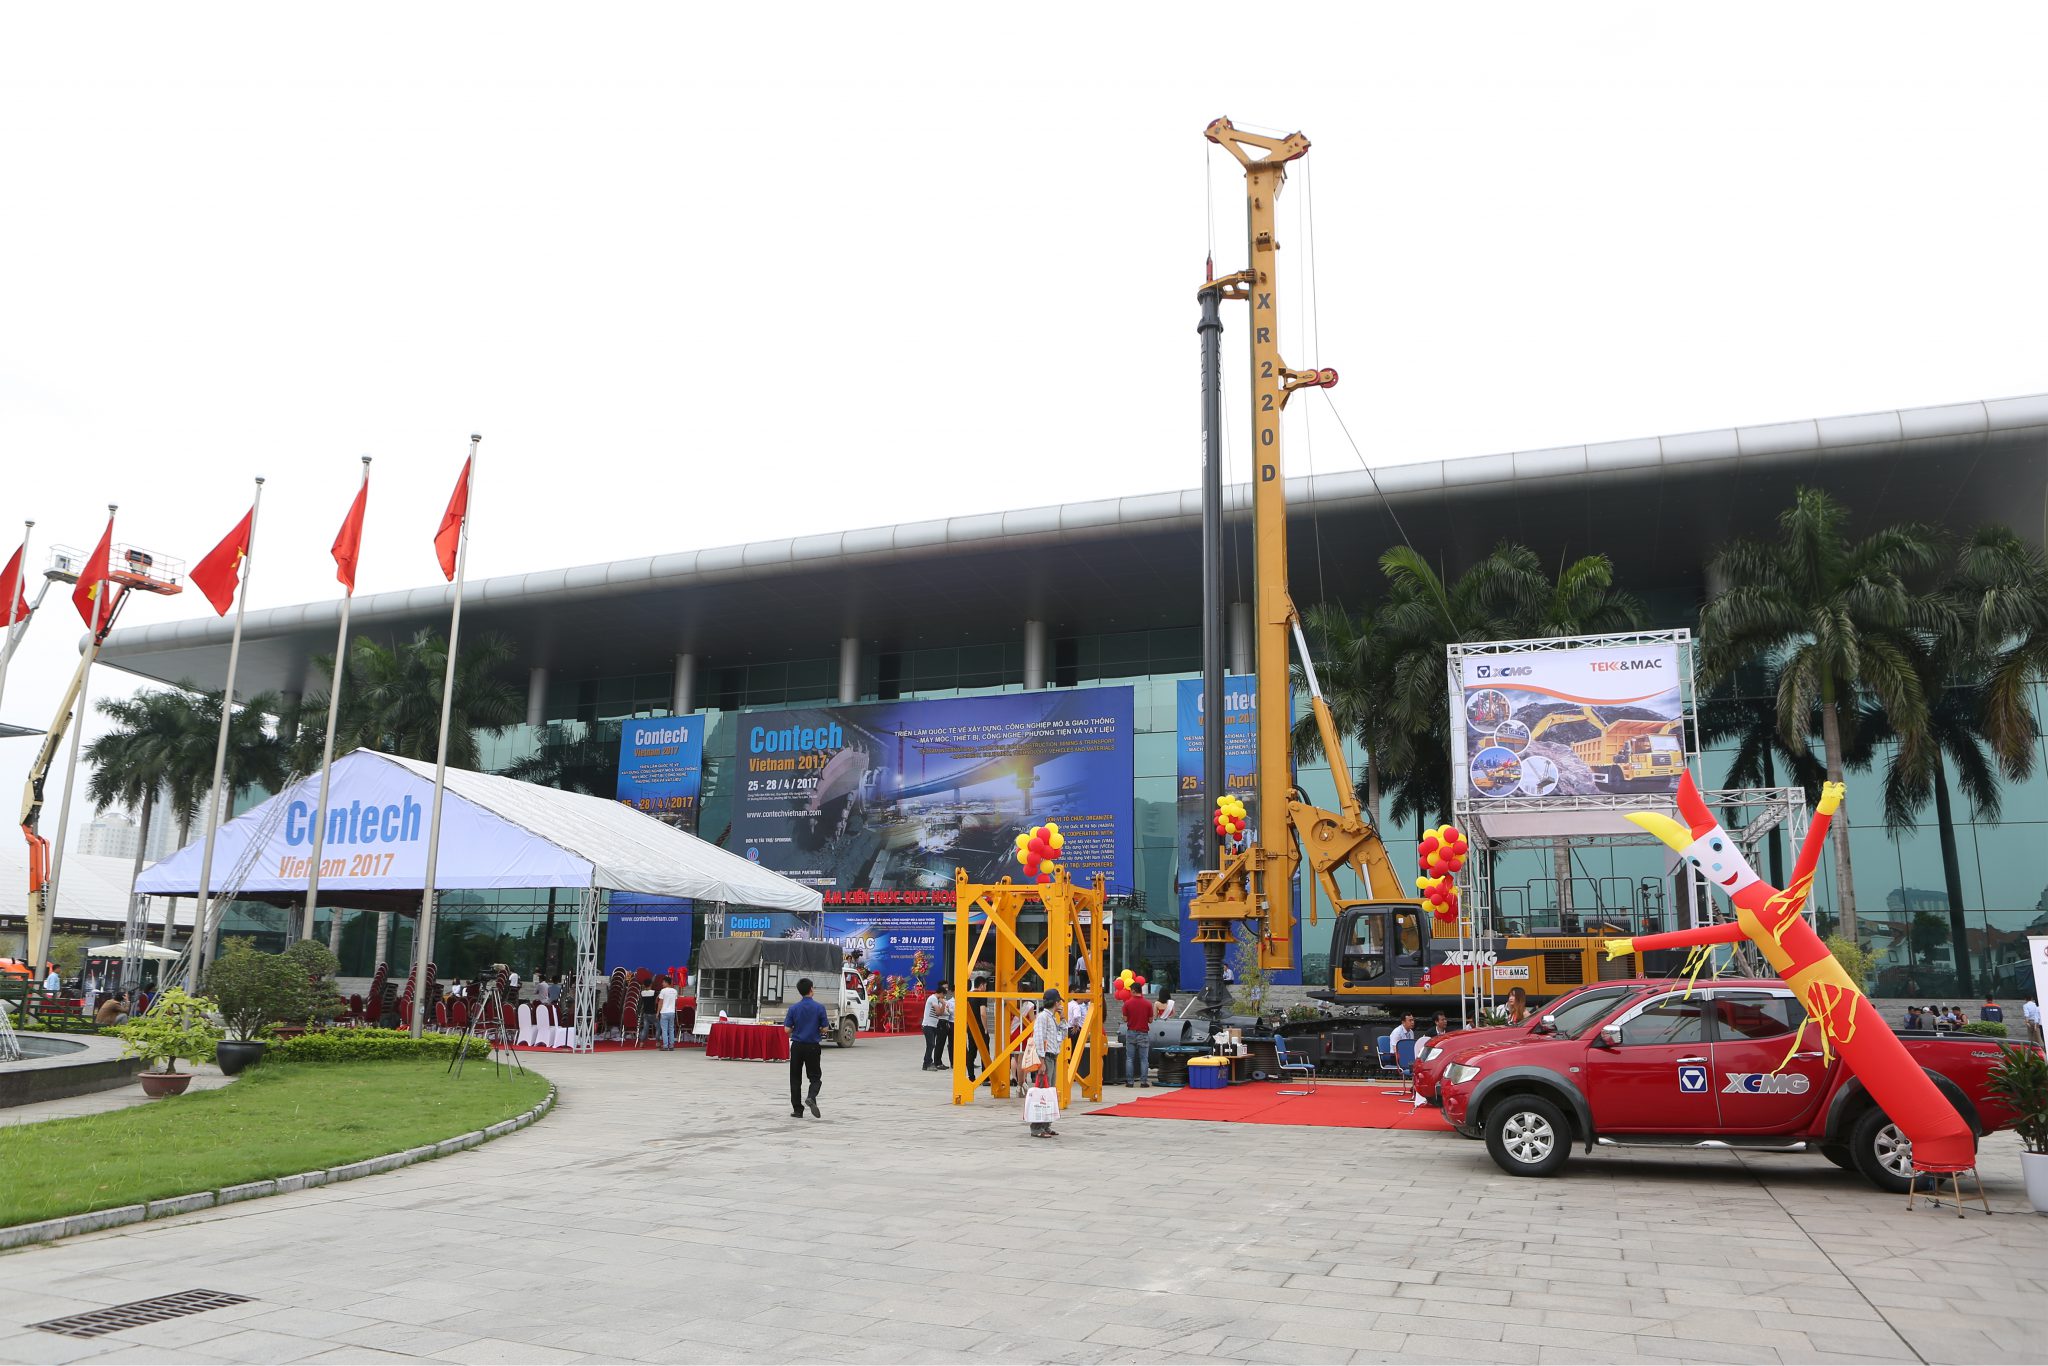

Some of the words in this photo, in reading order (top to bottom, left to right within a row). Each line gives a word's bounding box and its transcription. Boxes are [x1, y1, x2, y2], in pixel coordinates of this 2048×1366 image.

[1491, 666, 1532, 677] XCMG
[635, 726, 689, 746] Contech
[750, 722, 843, 754] Contech
[634, 748, 660, 757] Vietnam
[662, 746, 680, 756] 2017
[749, 757, 795, 772] Vietnam
[798, 754, 828, 770] 2017
[748, 780, 759, 792] 25
[766, 780, 777, 790] 28
[784, 780, 790, 790] 4
[797, 778, 818, 789] 2017
[1182, 776, 1198, 790] 25
[640, 798, 651, 810] 28
[671, 796, 694, 808] 2017
[286, 795, 422, 846] Contech
[746, 810, 822, 818] www.contechvietnam.com
[278, 856, 346, 878] Vietam
[349, 853, 396, 877] 2017
[873, 888, 900, 904] TRÚC
[902, 890, 928, 904] QUY
[730, 916, 771, 929] Contech
[1442, 950, 1498, 966] XCMG
[1721, 1072, 1810, 1094] XCMG
